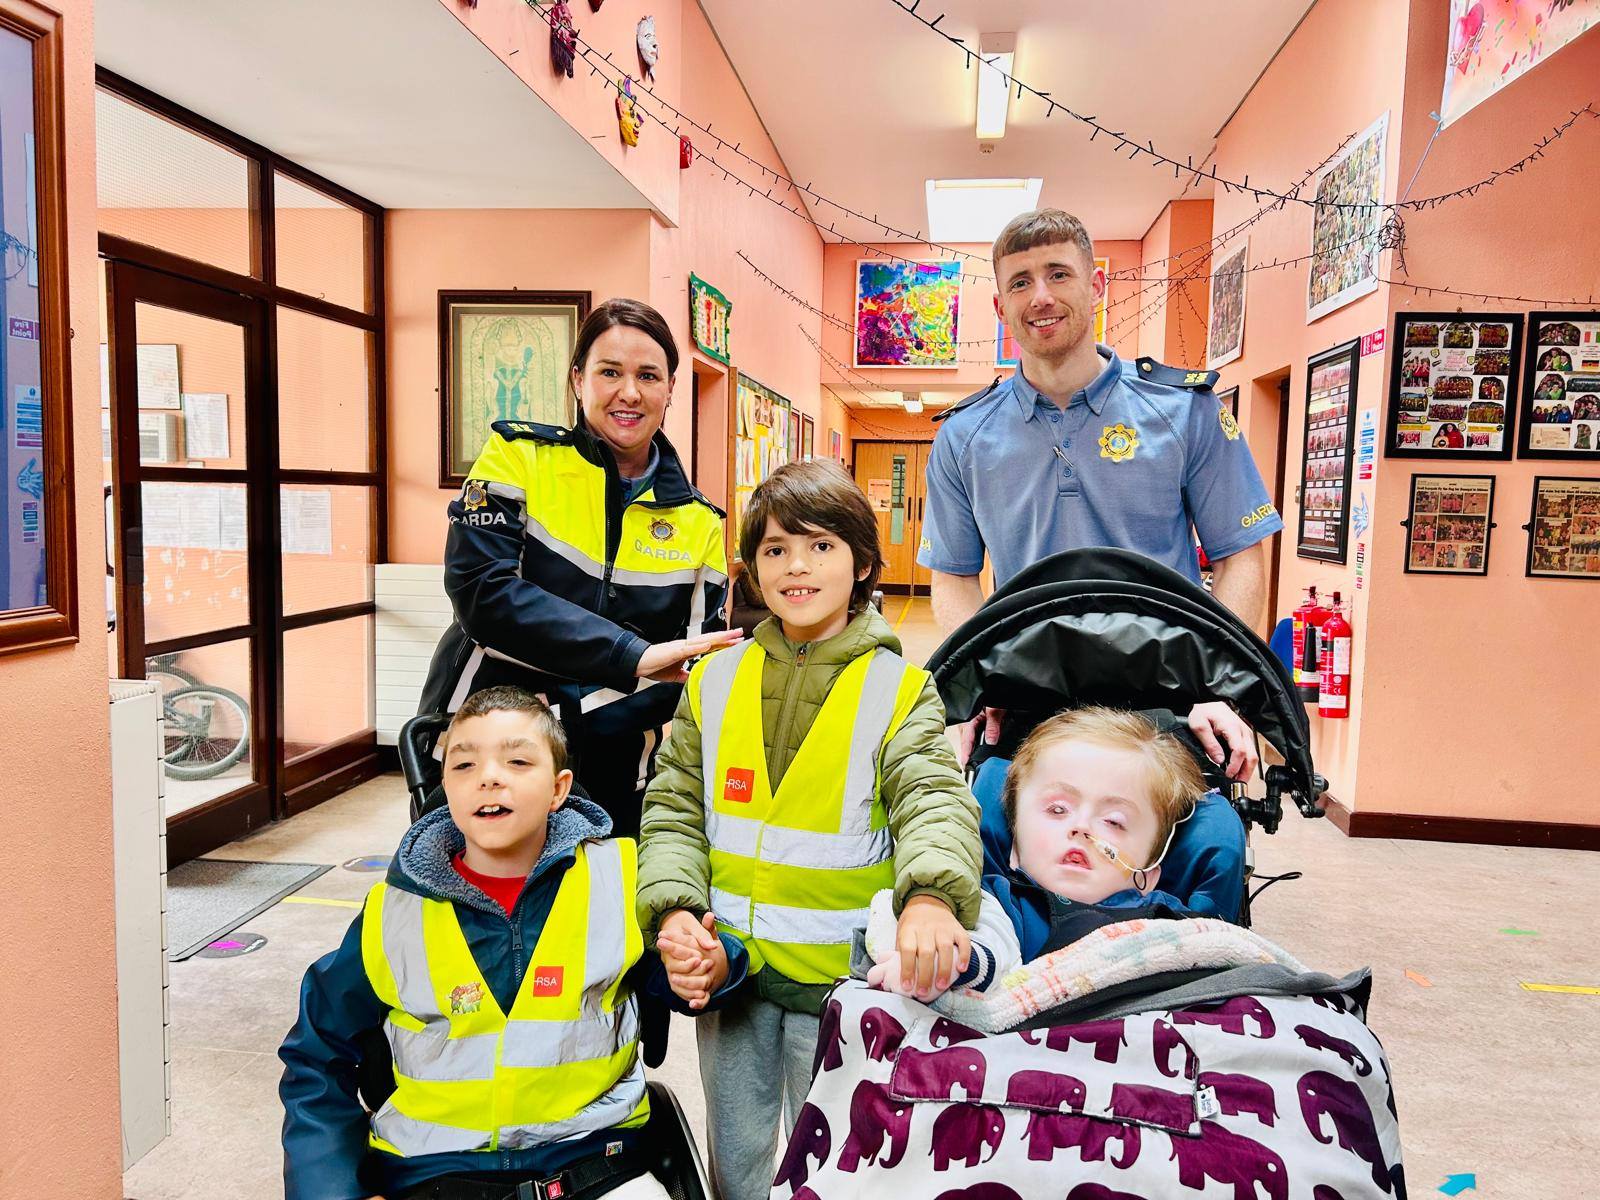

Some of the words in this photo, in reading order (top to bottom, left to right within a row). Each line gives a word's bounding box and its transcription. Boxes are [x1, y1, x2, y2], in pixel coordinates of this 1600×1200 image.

[635, 539, 693, 563] GARDA
[727, 778, 747, 791] RSA
[536, 976, 558, 987] RSA
